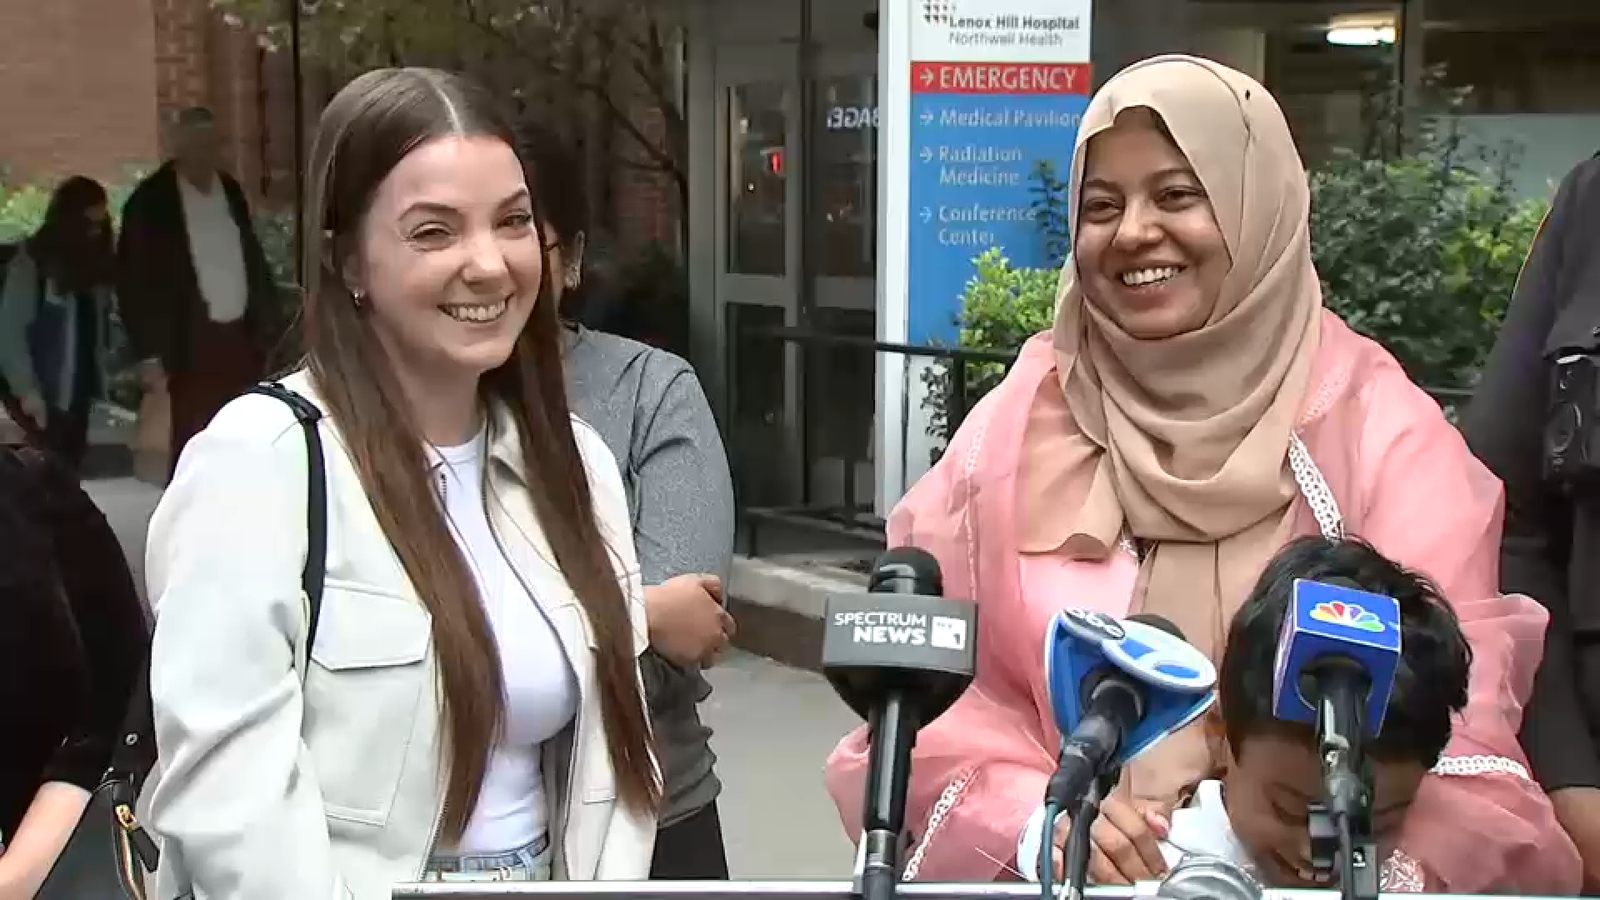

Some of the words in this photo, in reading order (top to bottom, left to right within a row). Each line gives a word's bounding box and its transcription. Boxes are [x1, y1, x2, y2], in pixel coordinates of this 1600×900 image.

[949, 15, 992, 29] Lenox
[996, 15, 1019, 30] Hill
[1023, 15, 1080, 33] Hospital
[949, 32, 1015, 46] Northwell
[1019, 33, 1064, 47] Health
[939, 66, 1077, 90] EMERGENCY
[940, 107, 1009, 127] Medical
[1013, 108, 1080, 128] Pavilion
[939, 145, 1022, 162] Radiation
[939, 166, 1021, 187] Medicine
[939, 204, 1037, 222] Conference
[938, 227, 994, 246] Center
[833, 611, 927, 628] SPECTRUM
[852, 626, 926, 646] NEWS
